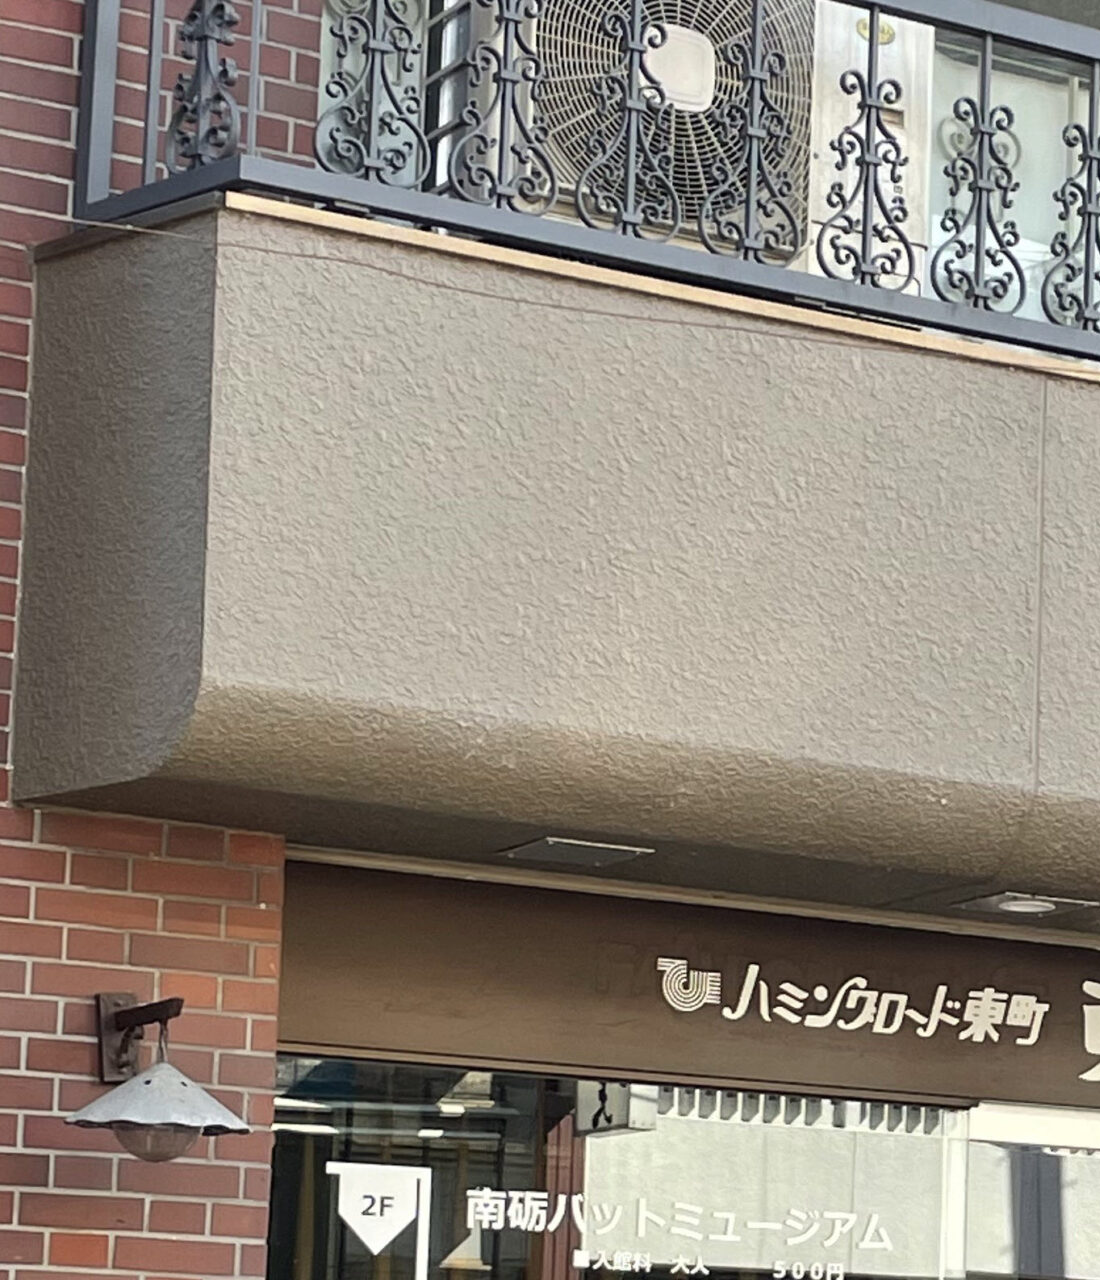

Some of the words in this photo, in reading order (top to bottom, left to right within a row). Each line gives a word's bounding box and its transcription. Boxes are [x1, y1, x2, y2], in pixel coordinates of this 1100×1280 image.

[722, 963, 1050, 1046] ハミングロード東町
[360, 1194, 395, 1217] 2F
[465, 1186, 894, 1252] 南砺バットミュージアム
[592, 1249, 652, 1273] 入館料
[669, 1254, 710, 1276] 大人
